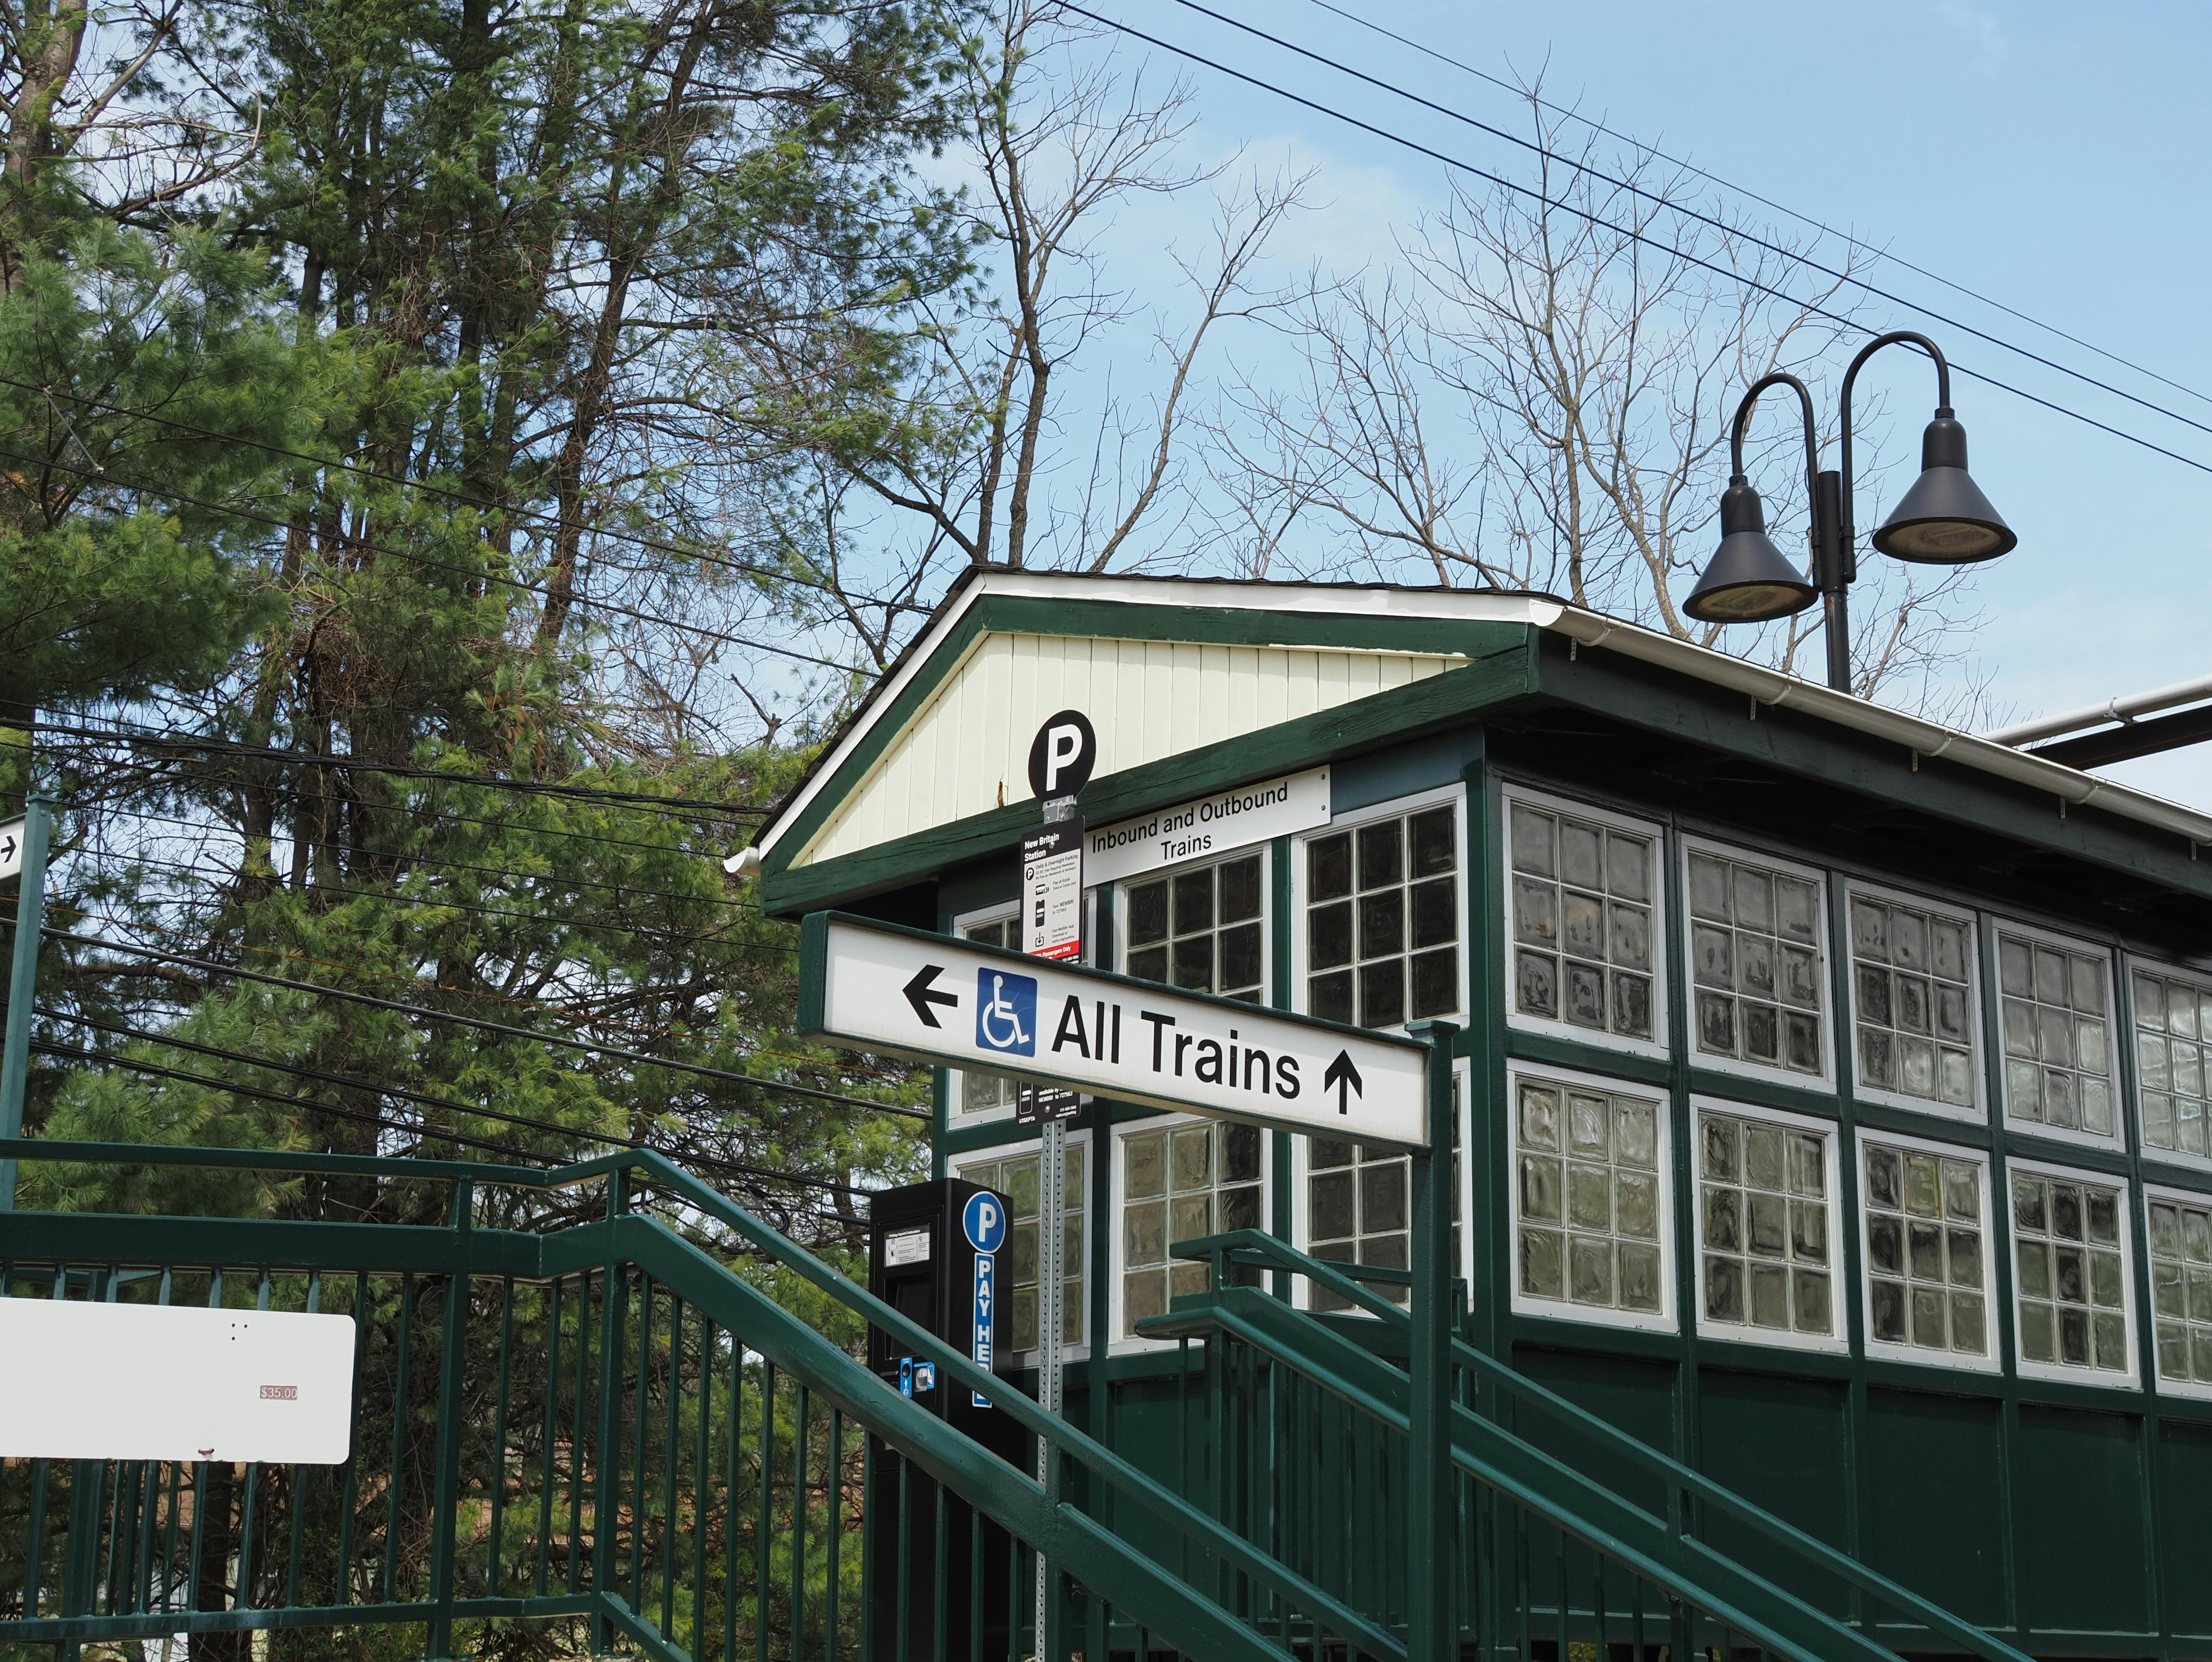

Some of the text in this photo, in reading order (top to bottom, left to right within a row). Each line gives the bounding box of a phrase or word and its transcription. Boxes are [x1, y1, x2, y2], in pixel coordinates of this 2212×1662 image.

[1046, 724, 1082, 792] P
[1092, 781, 1288, 853] Inbound and Outbound
[1025, 833, 1059, 850] New Britain
[1161, 835, 1211, 860] Trains
[1024, 850, 1046, 862] Station
[1048, 858, 1064, 866] Overnight
[1028, 869, 1033, 879] P
[1042, 948, 1063, 957] Passengers
[1052, 995, 1300, 1099] All Trains
[978, 1202, 996, 1242] P
[978, 1260, 991, 1316] PAY
[261, 1387, 297, 1398] $35.00
